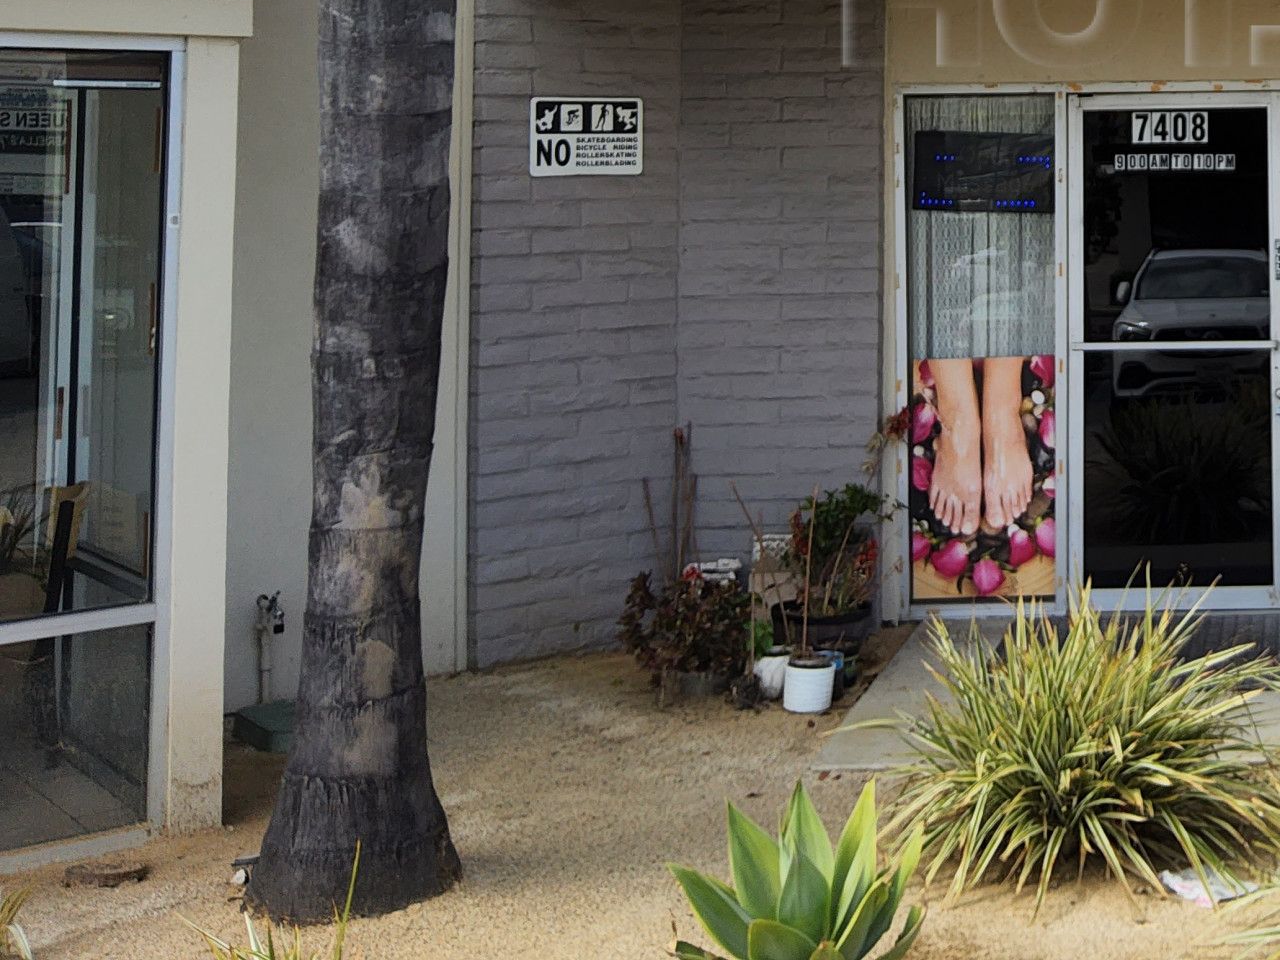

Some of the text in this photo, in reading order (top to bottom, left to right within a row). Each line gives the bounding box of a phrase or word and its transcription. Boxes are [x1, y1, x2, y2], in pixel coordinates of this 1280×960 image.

[1134, 112, 1206, 142] 7408
[536, 138, 571, 167] NO
[1150, 154, 1169, 169] AM
[1173, 154, 1191, 169] TO
[1196, 154, 1213, 169] 10
[1217, 154, 1235, 169] PM
